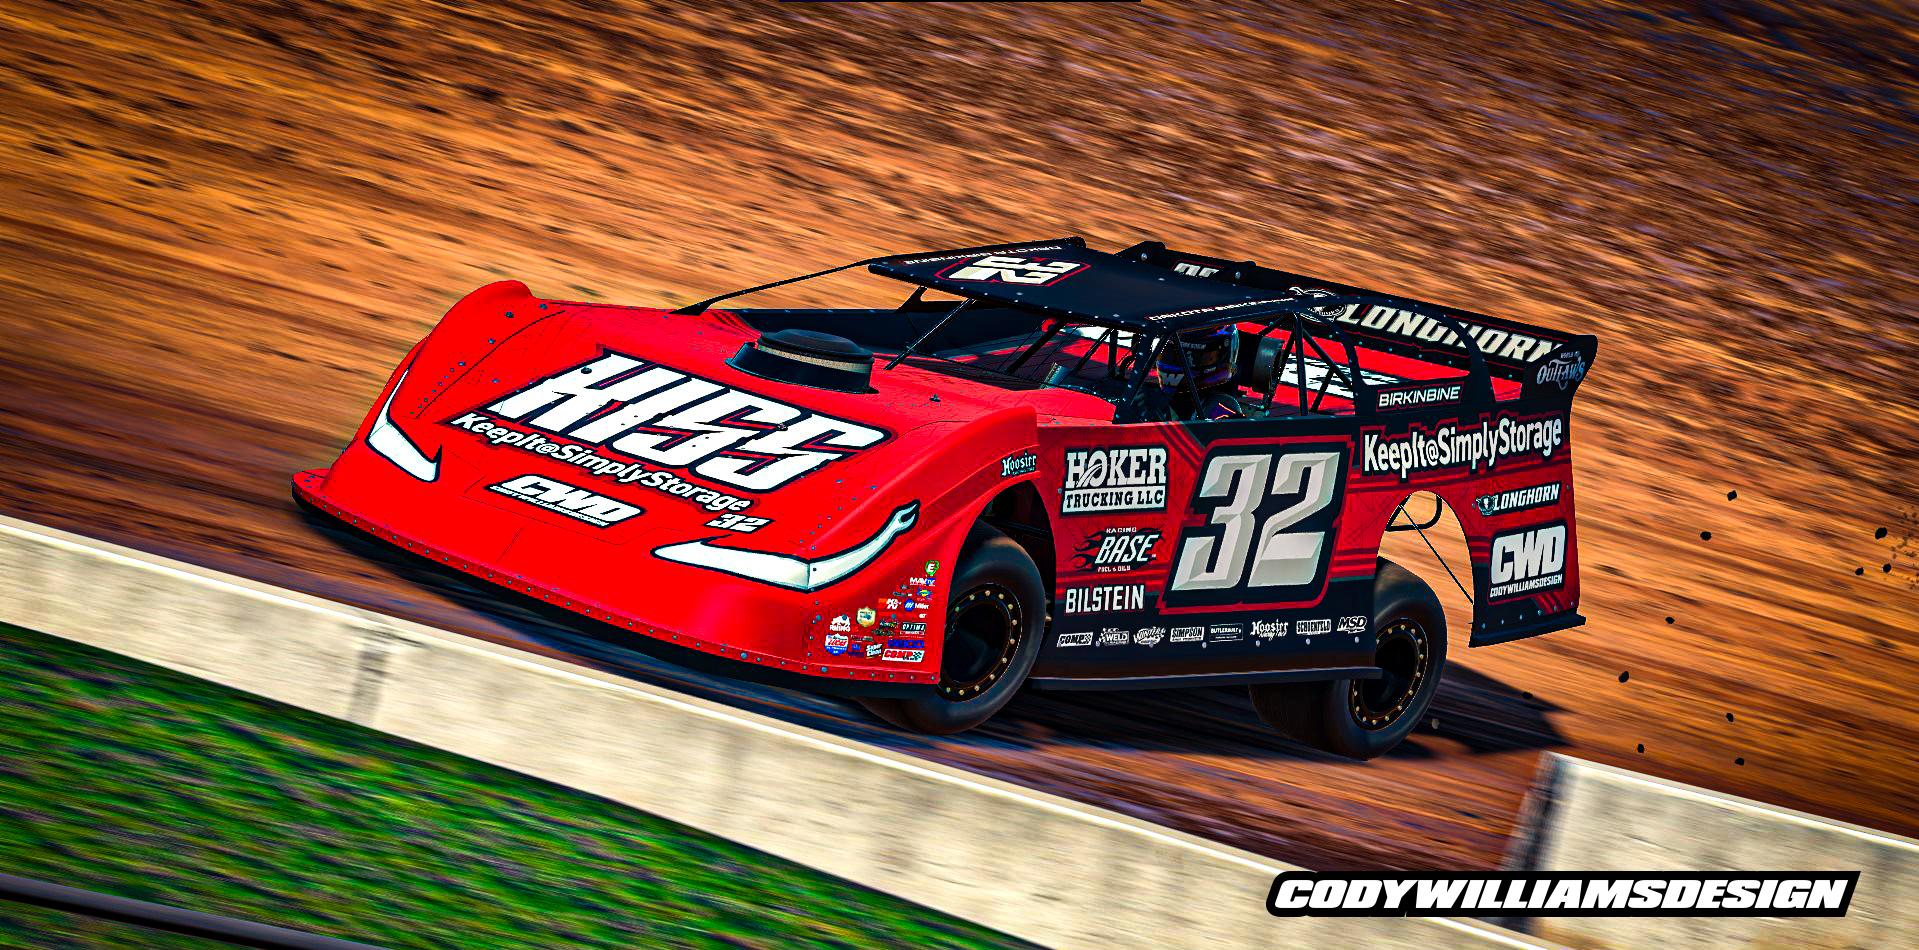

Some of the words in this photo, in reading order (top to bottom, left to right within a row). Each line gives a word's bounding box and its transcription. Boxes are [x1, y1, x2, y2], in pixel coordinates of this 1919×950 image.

[1378, 386, 1462, 407] BIRKINBINE
[487, 352, 892, 492] KISS
[450, 411, 752, 512] KeepIt@SimplyStorage
[1364, 417, 1562, 478] KeepIt@SimplyStorage
[1065, 448, 1167, 489] HOKER
[500, 475, 643, 523] CWD
[1066, 491, 1134, 508] TRUCKING
[1136, 489, 1164, 505] LLC
[1493, 483, 1560, 511] LONGHORN
[706, 513, 771, 533] 32
[1171, 452, 1341, 591] 32
[1095, 534, 1159, 564] BASE
[1490, 525, 1566, 585] CWD
[1065, 585, 1145, 613] BILSTEIN
[1489, 574, 1563, 599] CODYWILLIAMSDESIGN
[1105, 632, 1128, 642] WELD
[1338, 616, 1367, 630] MSD
